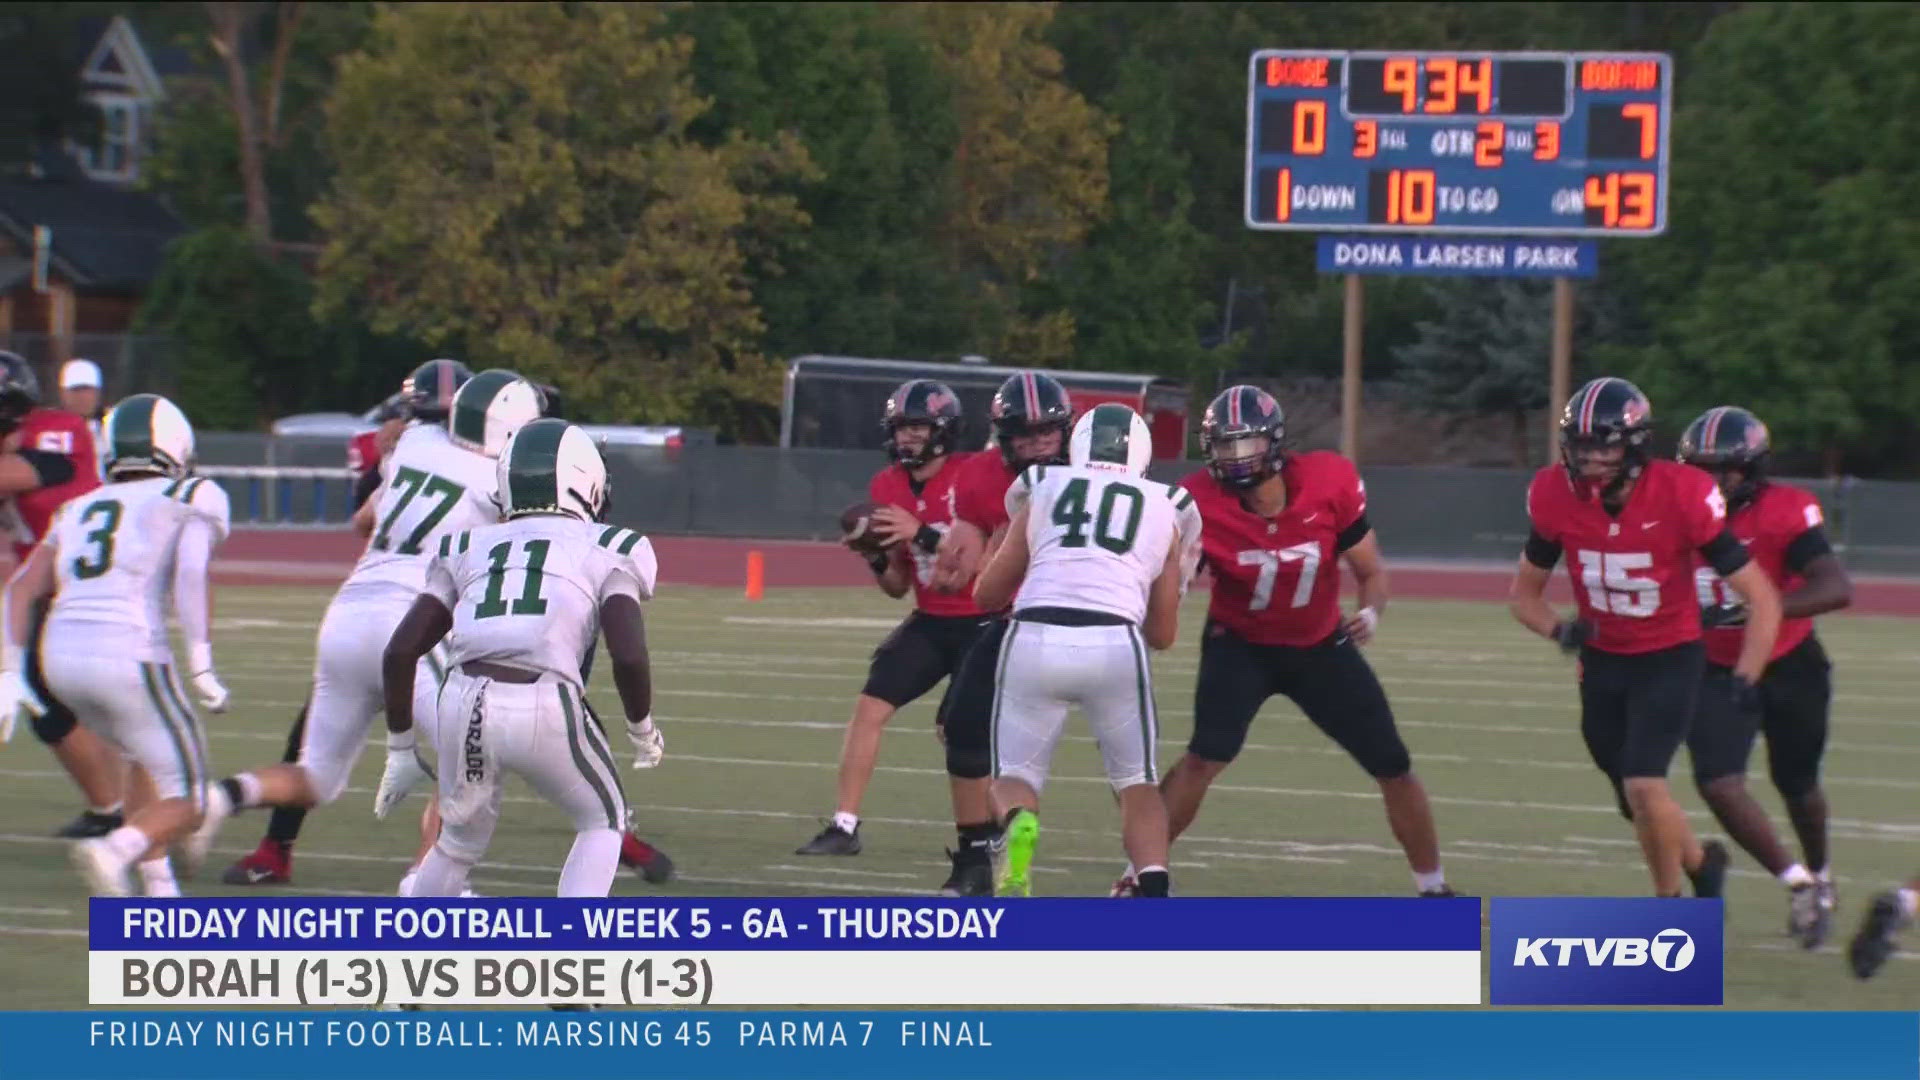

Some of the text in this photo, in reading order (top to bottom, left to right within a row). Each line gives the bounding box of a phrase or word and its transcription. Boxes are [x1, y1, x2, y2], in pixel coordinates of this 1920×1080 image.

[1292, 99, 1326, 156] 0
[1353, 120, 1377, 158] 3
[1475, 121, 1504, 168] 2
[1533, 121, 1560, 161] 3
[1621, 102, 1658, 160] 7
[1277, 168, 1356, 223] 1 DOWN
[1387, 169, 1436, 225] 10
[1551, 172, 1656, 229] ON 43
[1334, 243, 1579, 270] DONA LARSEN PARK
[373, 464, 467, 556] 77
[1051, 477, 1145, 556] 40
[72, 499, 124, 580] 3
[474, 539, 551, 620] 11
[1237, 540, 1322, 611] 77
[1578, 548, 1662, 618] 15
